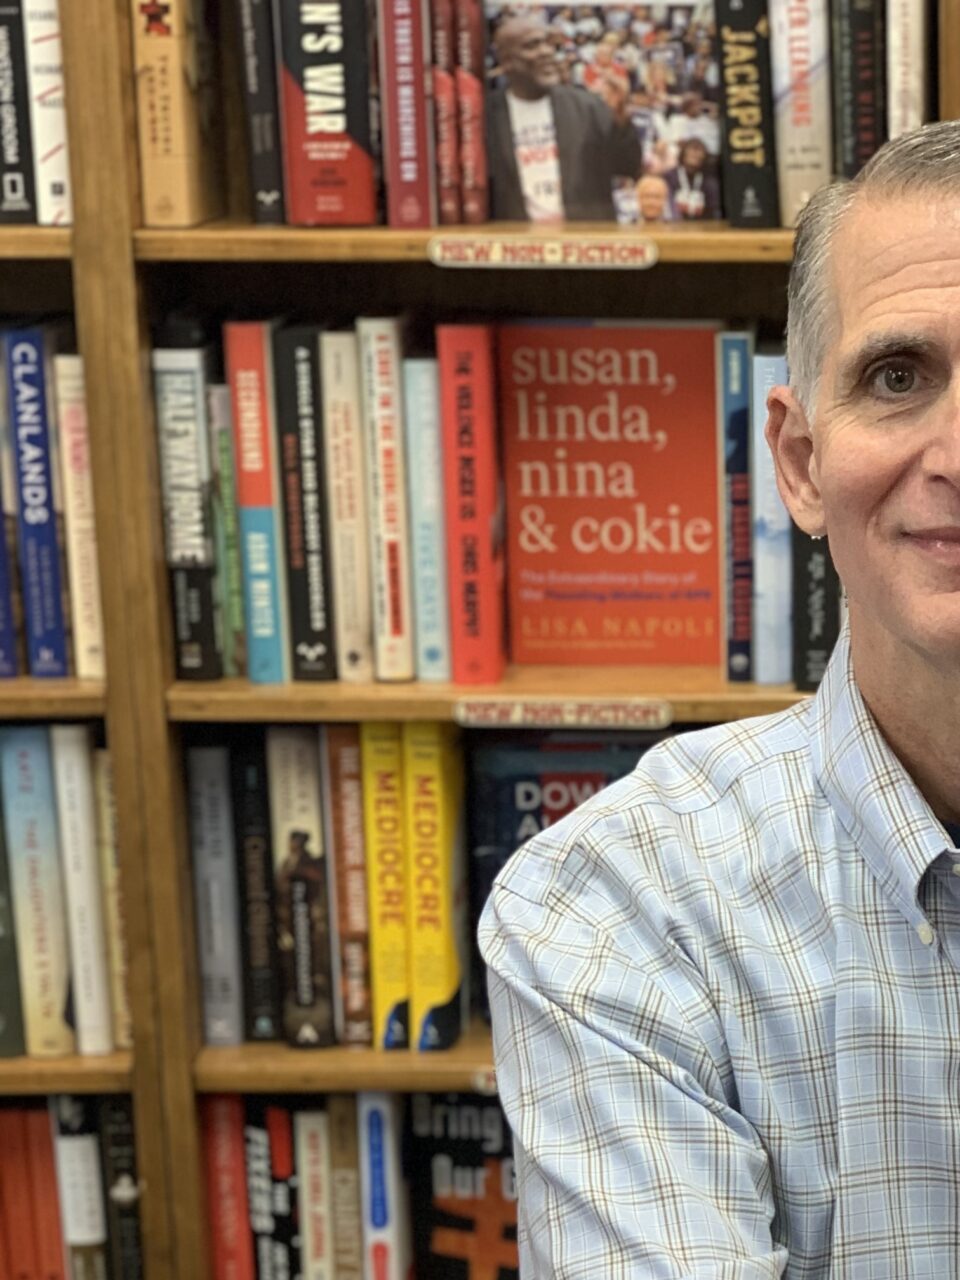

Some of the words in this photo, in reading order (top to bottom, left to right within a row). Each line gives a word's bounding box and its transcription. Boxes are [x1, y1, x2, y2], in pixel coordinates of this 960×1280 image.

[394, 18, 415, 65] TRUTH
[303, 64, 347, 134] WAR
[396, 67, 416, 83] IS
[721, 25, 766, 167] JACKPOT
[2, 104, 20, 164] GROOM
[397, 85, 417, 157] MARCHING
[401, 161, 418, 182] ON
[440, 240, 492, 262] NEW
[511, 345, 677, 396] susan,
[11, 341, 50, 527] CLANLANDS
[236, 370, 264, 472] SECONDHAND
[515, 389, 668, 452] linda,
[518, 448, 638, 500] nina
[168, 490, 208, 565] HOME
[518, 503, 558, 554] &
[571, 503, 713, 555] cokie
[521, 616, 589, 637] LISA
[598, 615, 715, 638] NAPOLI
[373, 769, 407, 930] MEDIOCRE
[413, 772, 442, 933] MEDIOCRE
